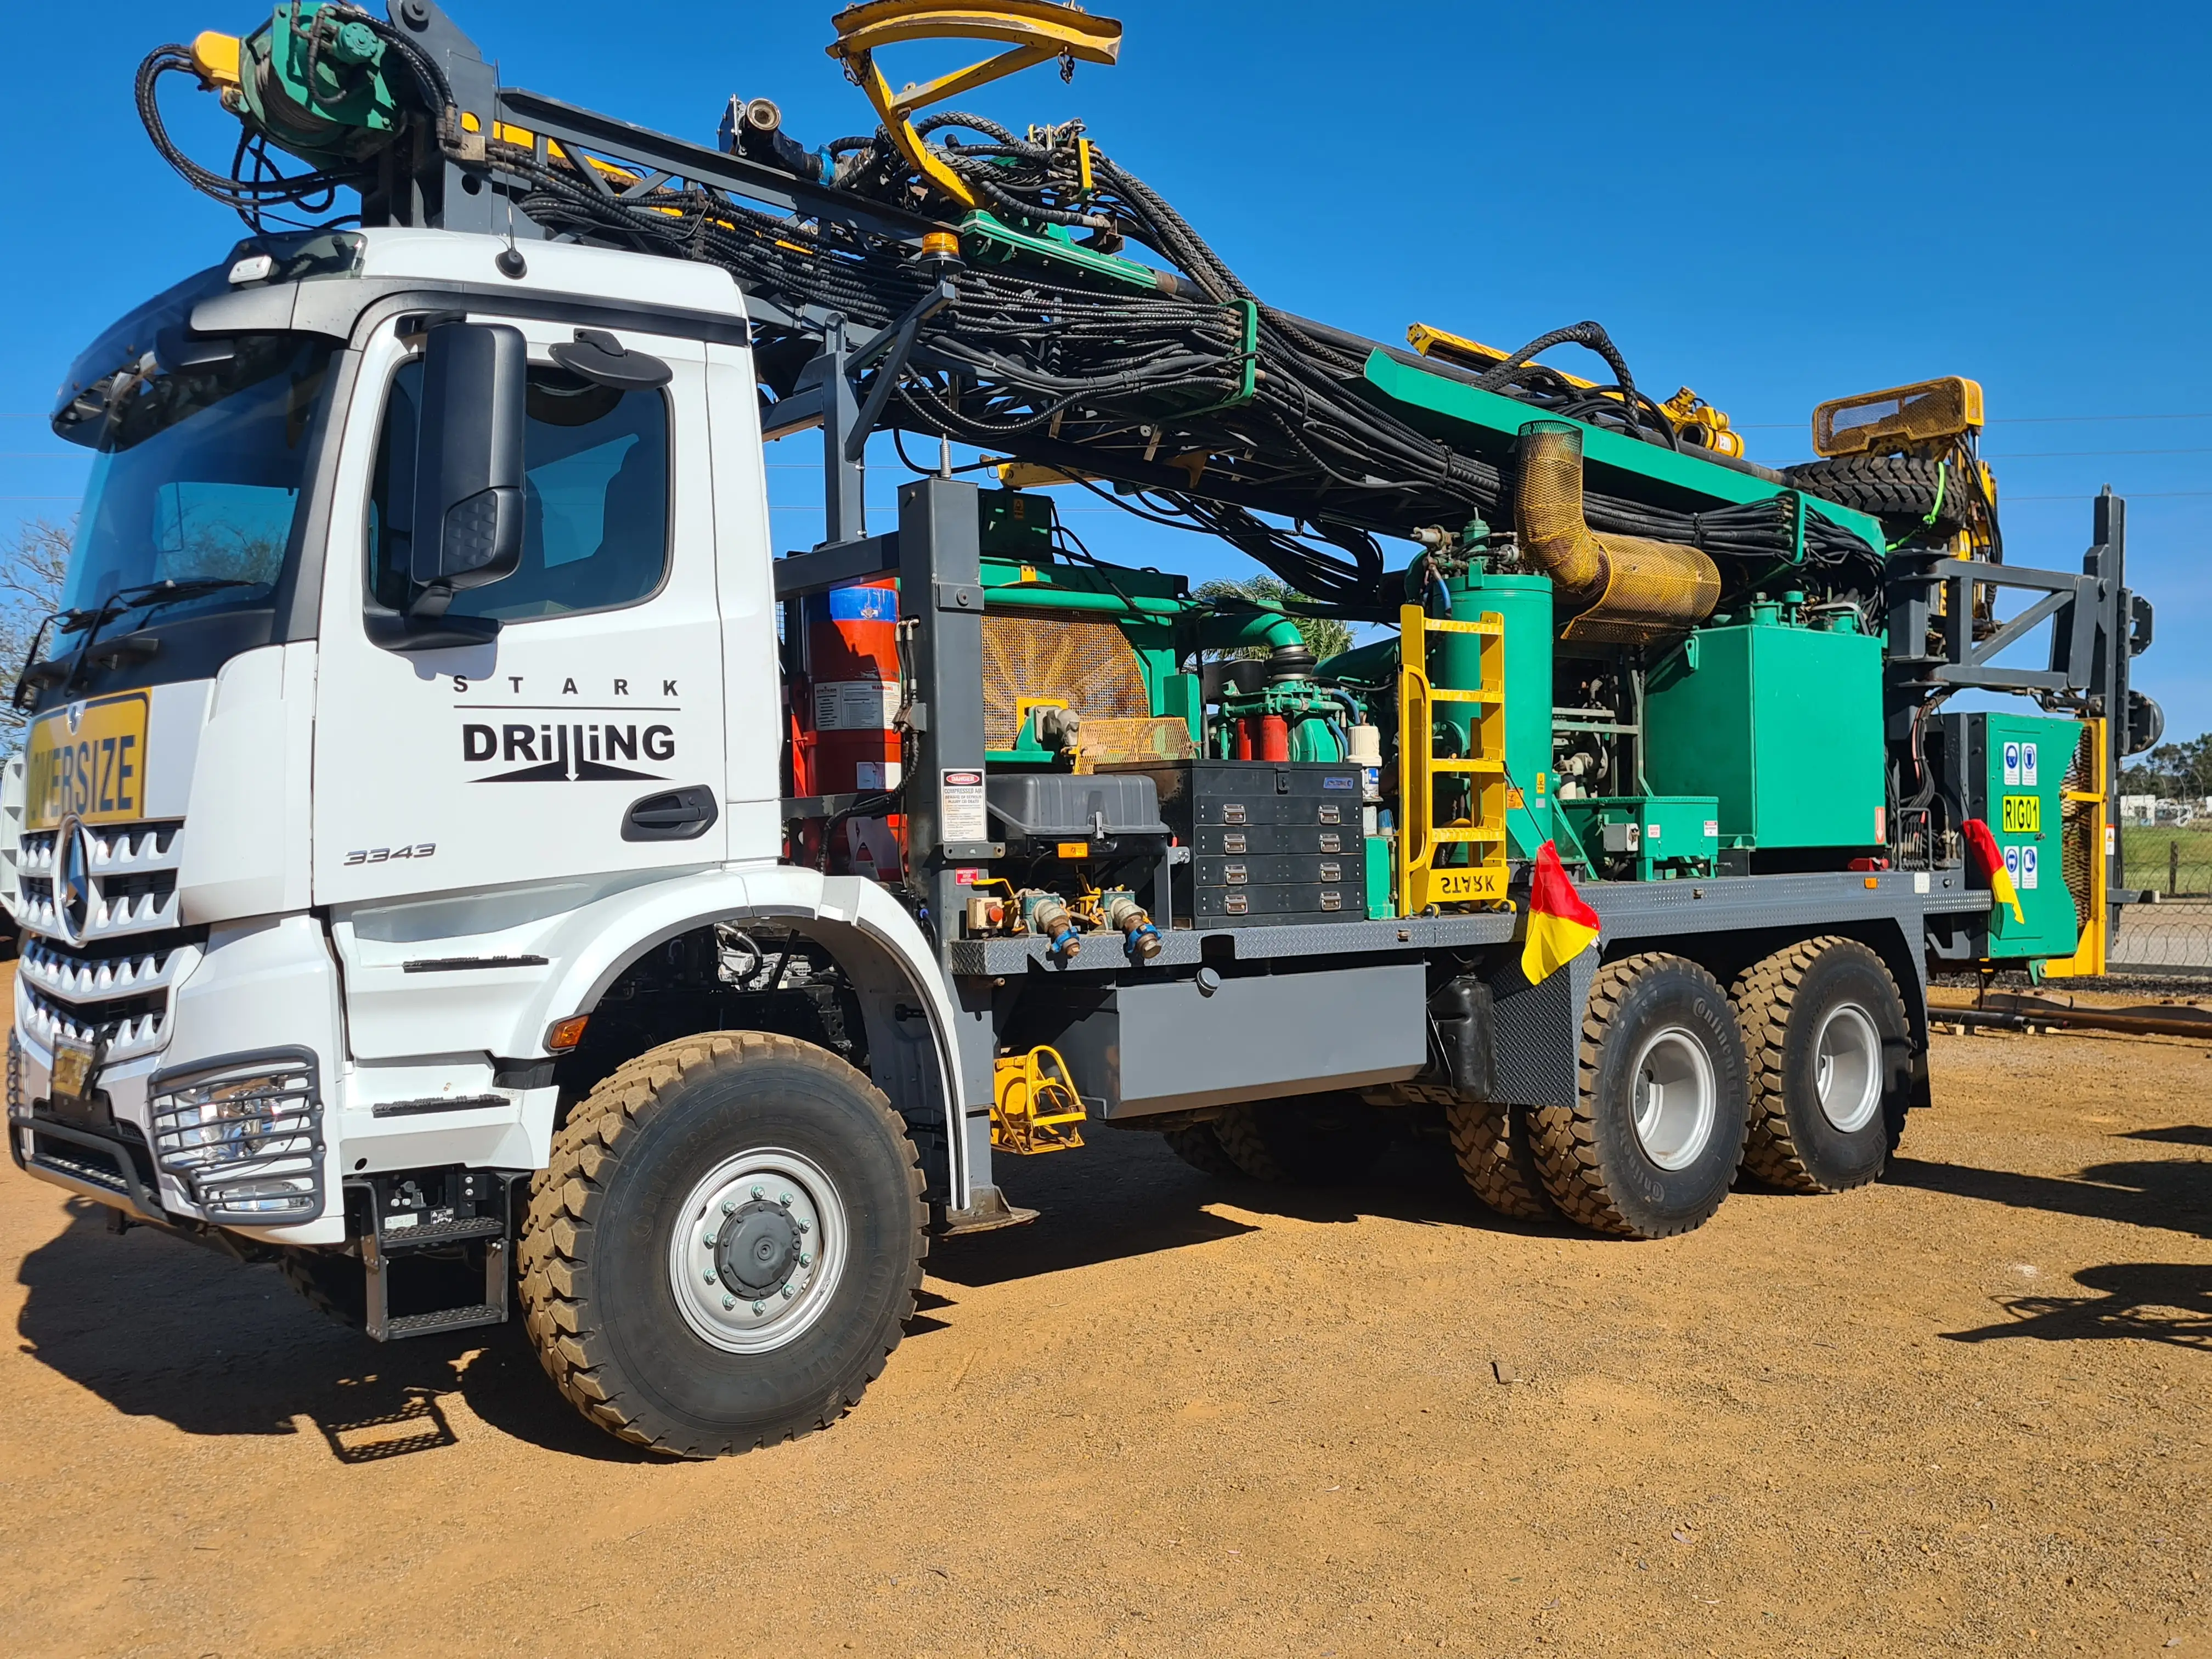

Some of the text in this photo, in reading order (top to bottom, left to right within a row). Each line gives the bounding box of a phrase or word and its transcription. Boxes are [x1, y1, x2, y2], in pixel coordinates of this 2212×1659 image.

[453, 675, 679, 696] STARK
[2005, 799, 2038, 830] RIG01
[343, 843, 437, 866] 3343
